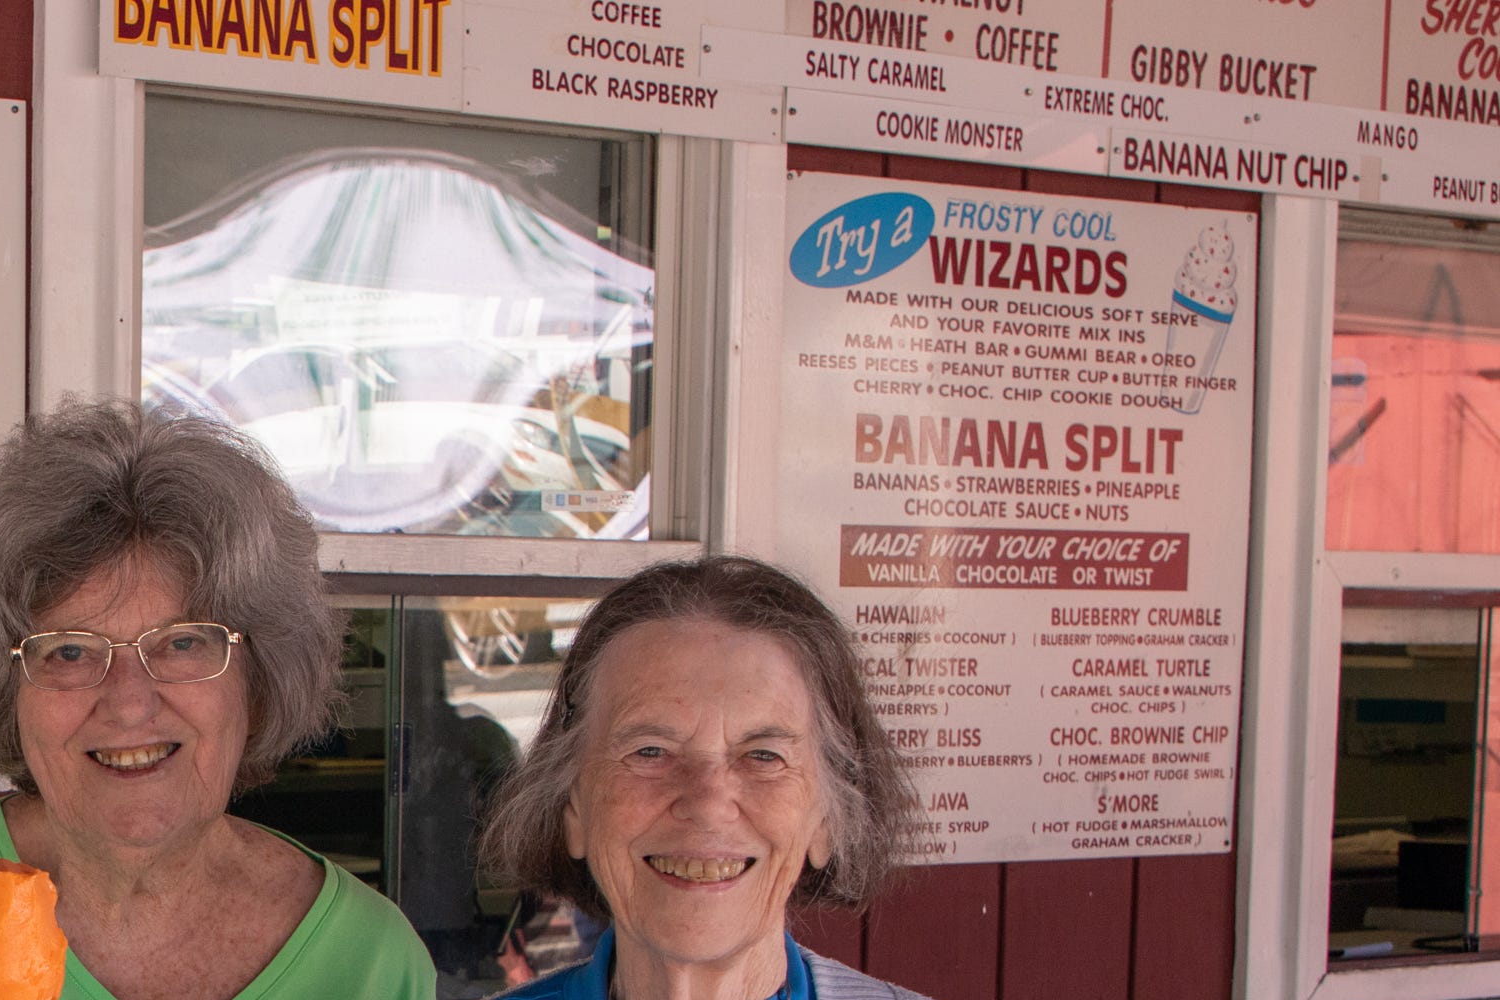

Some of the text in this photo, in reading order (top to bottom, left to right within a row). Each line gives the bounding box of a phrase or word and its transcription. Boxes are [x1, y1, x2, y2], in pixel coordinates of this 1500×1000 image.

[592, 0, 661, 28] COFFEE
[114, 0, 452, 77] BANANA SPLIT
[567, 35, 684, 68] CHOCOLATE
[813, 0, 1059, 72] BROWNIE COFFEE
[806, 50, 946, 92] SALTY CARAMEL
[1131, 45, 1317, 101] GIBBY BUCKET
[532, 69, 718, 109] BLACK RASPBERRY
[1045, 86, 1168, 122] EXTREME CHOC.
[876, 111, 1023, 152] COOKIE MONSTER
[1357, 121, 1418, 151] MANGO
[1124, 138, 1347, 190] BANANA NUT CHIP
[1433, 176, 1485, 202] PEANUT
[944, 202, 1116, 241] FROSTY COOL
[816, 206, 914, 279] Try a
[926, 234, 1127, 298] WIZARDS
[846, 290, 1198, 327] MADE WITH OUR DELICIOUS SOFT SERVE
[890, 314, 1145, 344] AND YOUR FAVORITE MIX INS
[911, 338, 966, 355] HEATH
[975, 342, 1008, 357] BAR
[1025, 345, 1086, 361] GUMMI
[1095, 349, 1136, 364] BEAR
[1152, 352, 1196, 368] OREO
[856, 412, 1183, 474] BANANA SPLIT
[854, 472, 1179, 500] BANANAS STRAWBERRIES PINEAPPLE
[904, 498, 1129, 522] CHOCOLATE SAUCE NUTS
[851, 533, 1181, 563] MADE WITH YOUR CHOICE OF
[868, 564, 1154, 586] VANILLA CHOCOLATE OR TWIST
[1051, 607, 1221, 626] BLUEBERRY CRUMBLE
[1072, 659, 1210, 677] CARAMEL TURTLE
[1050, 726, 1228, 746] CHOC. BROWNIE CHIP
[1098, 792, 1158, 814] S'MORE
